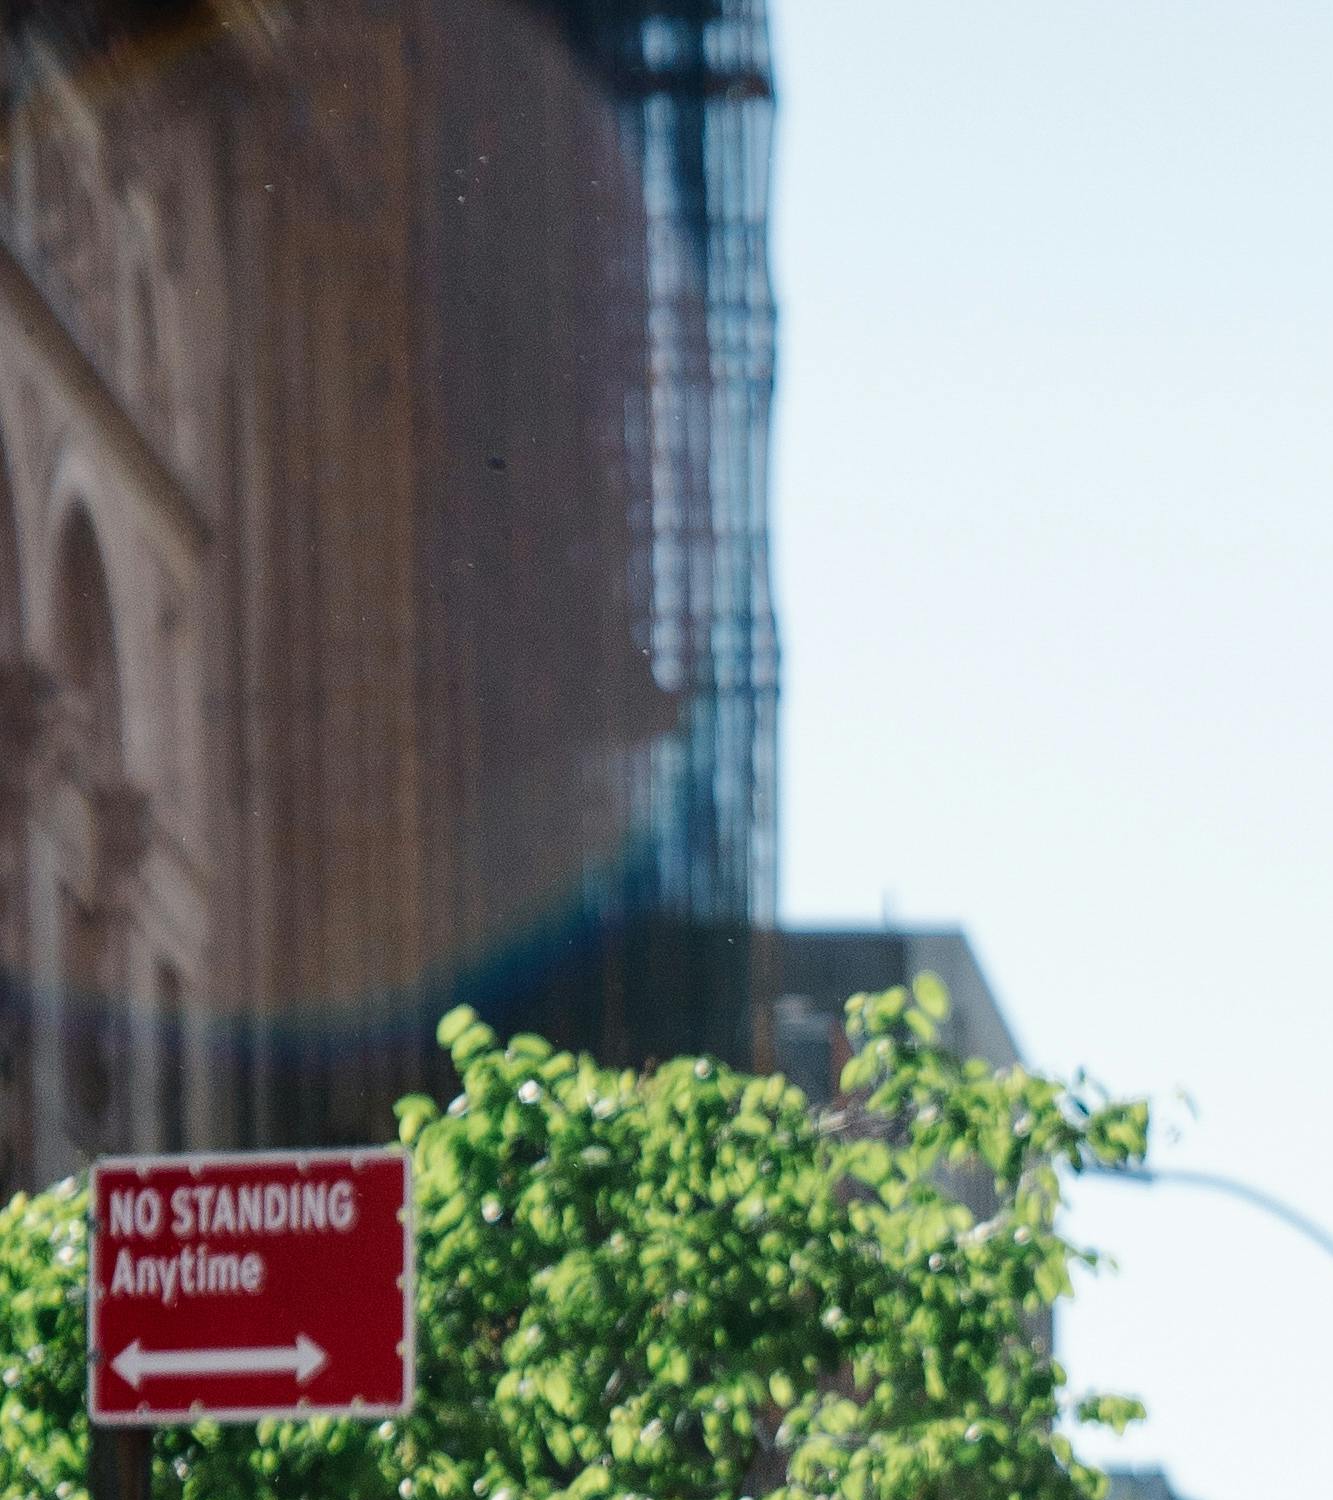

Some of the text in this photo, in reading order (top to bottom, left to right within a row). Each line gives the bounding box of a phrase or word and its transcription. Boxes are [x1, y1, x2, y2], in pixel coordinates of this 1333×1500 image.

[110, 1179, 356, 1239] NO STANDING
[112, 1244, 266, 1306] Anytime
